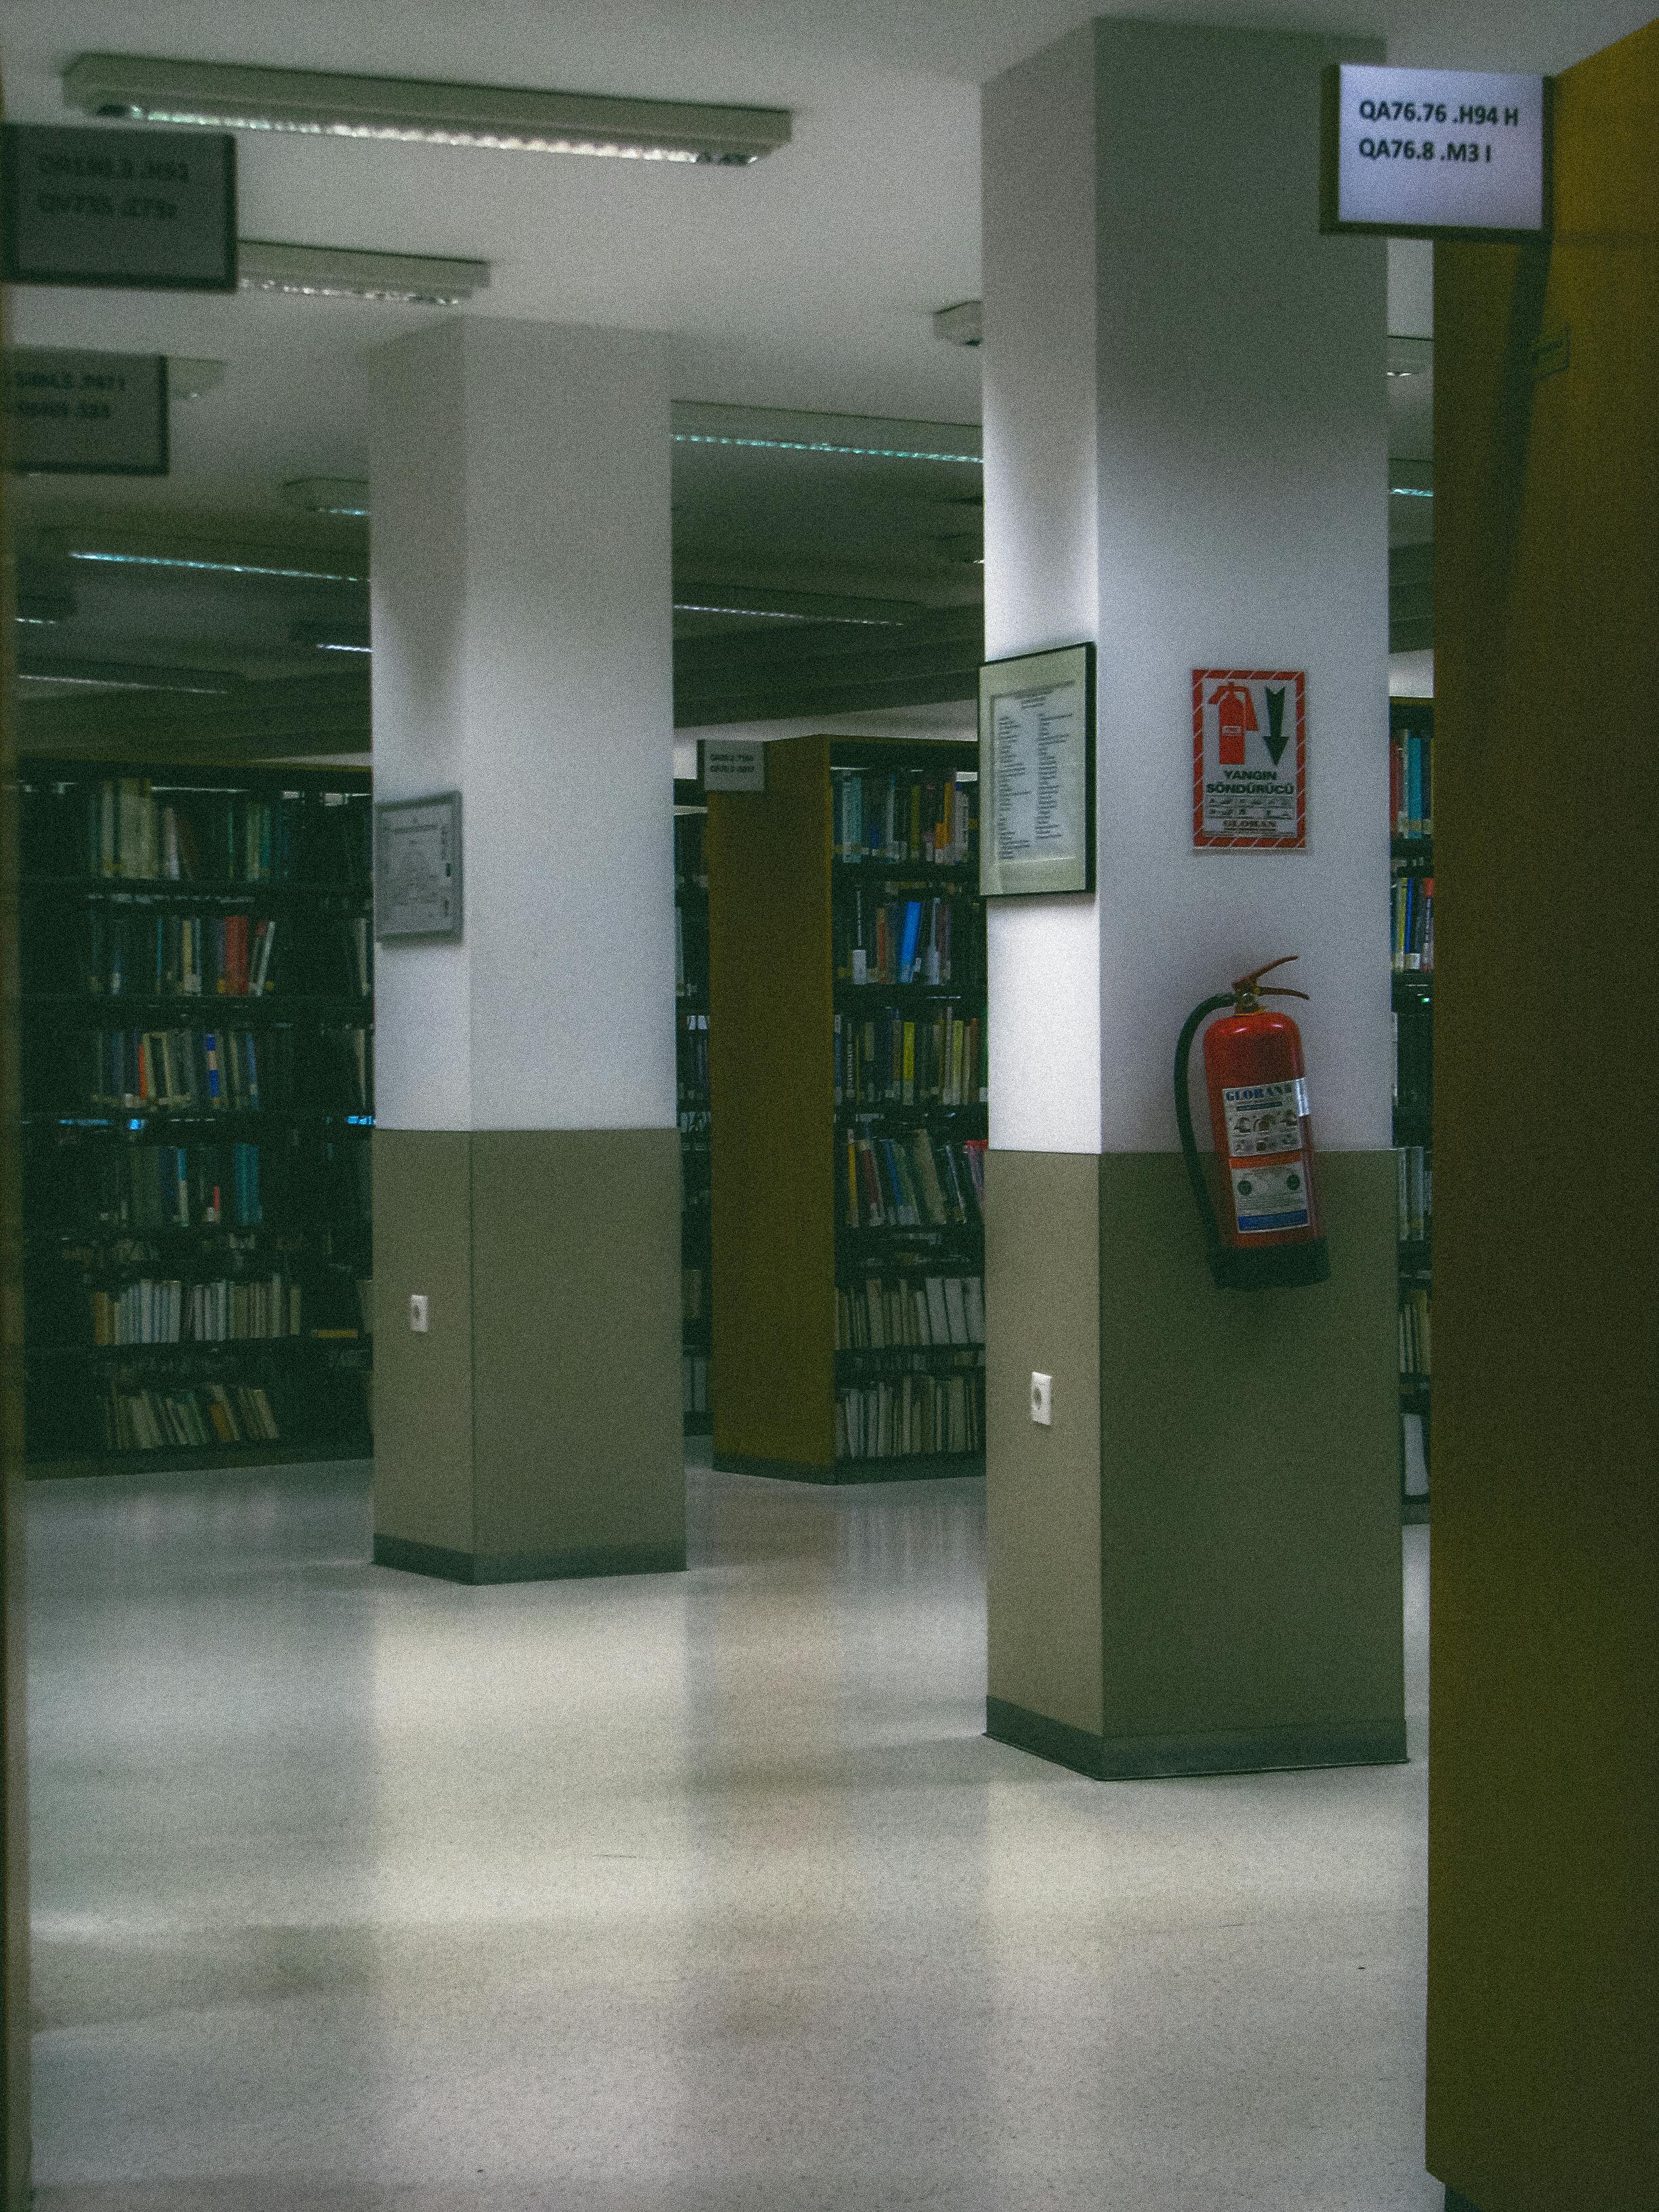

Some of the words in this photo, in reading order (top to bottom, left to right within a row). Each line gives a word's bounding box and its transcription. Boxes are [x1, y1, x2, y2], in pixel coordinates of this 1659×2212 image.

[1359, 100, 1448, 123] QA76.76
[1452, 105, 1499, 125] .H94
[1504, 106, 1519, 127] H
[1359, 138, 1435, 161] QA76.8
[1223, 769, 1277, 780] YANGIN
[1206, 781, 1294, 795] SÖNDÜRÜCÜ
